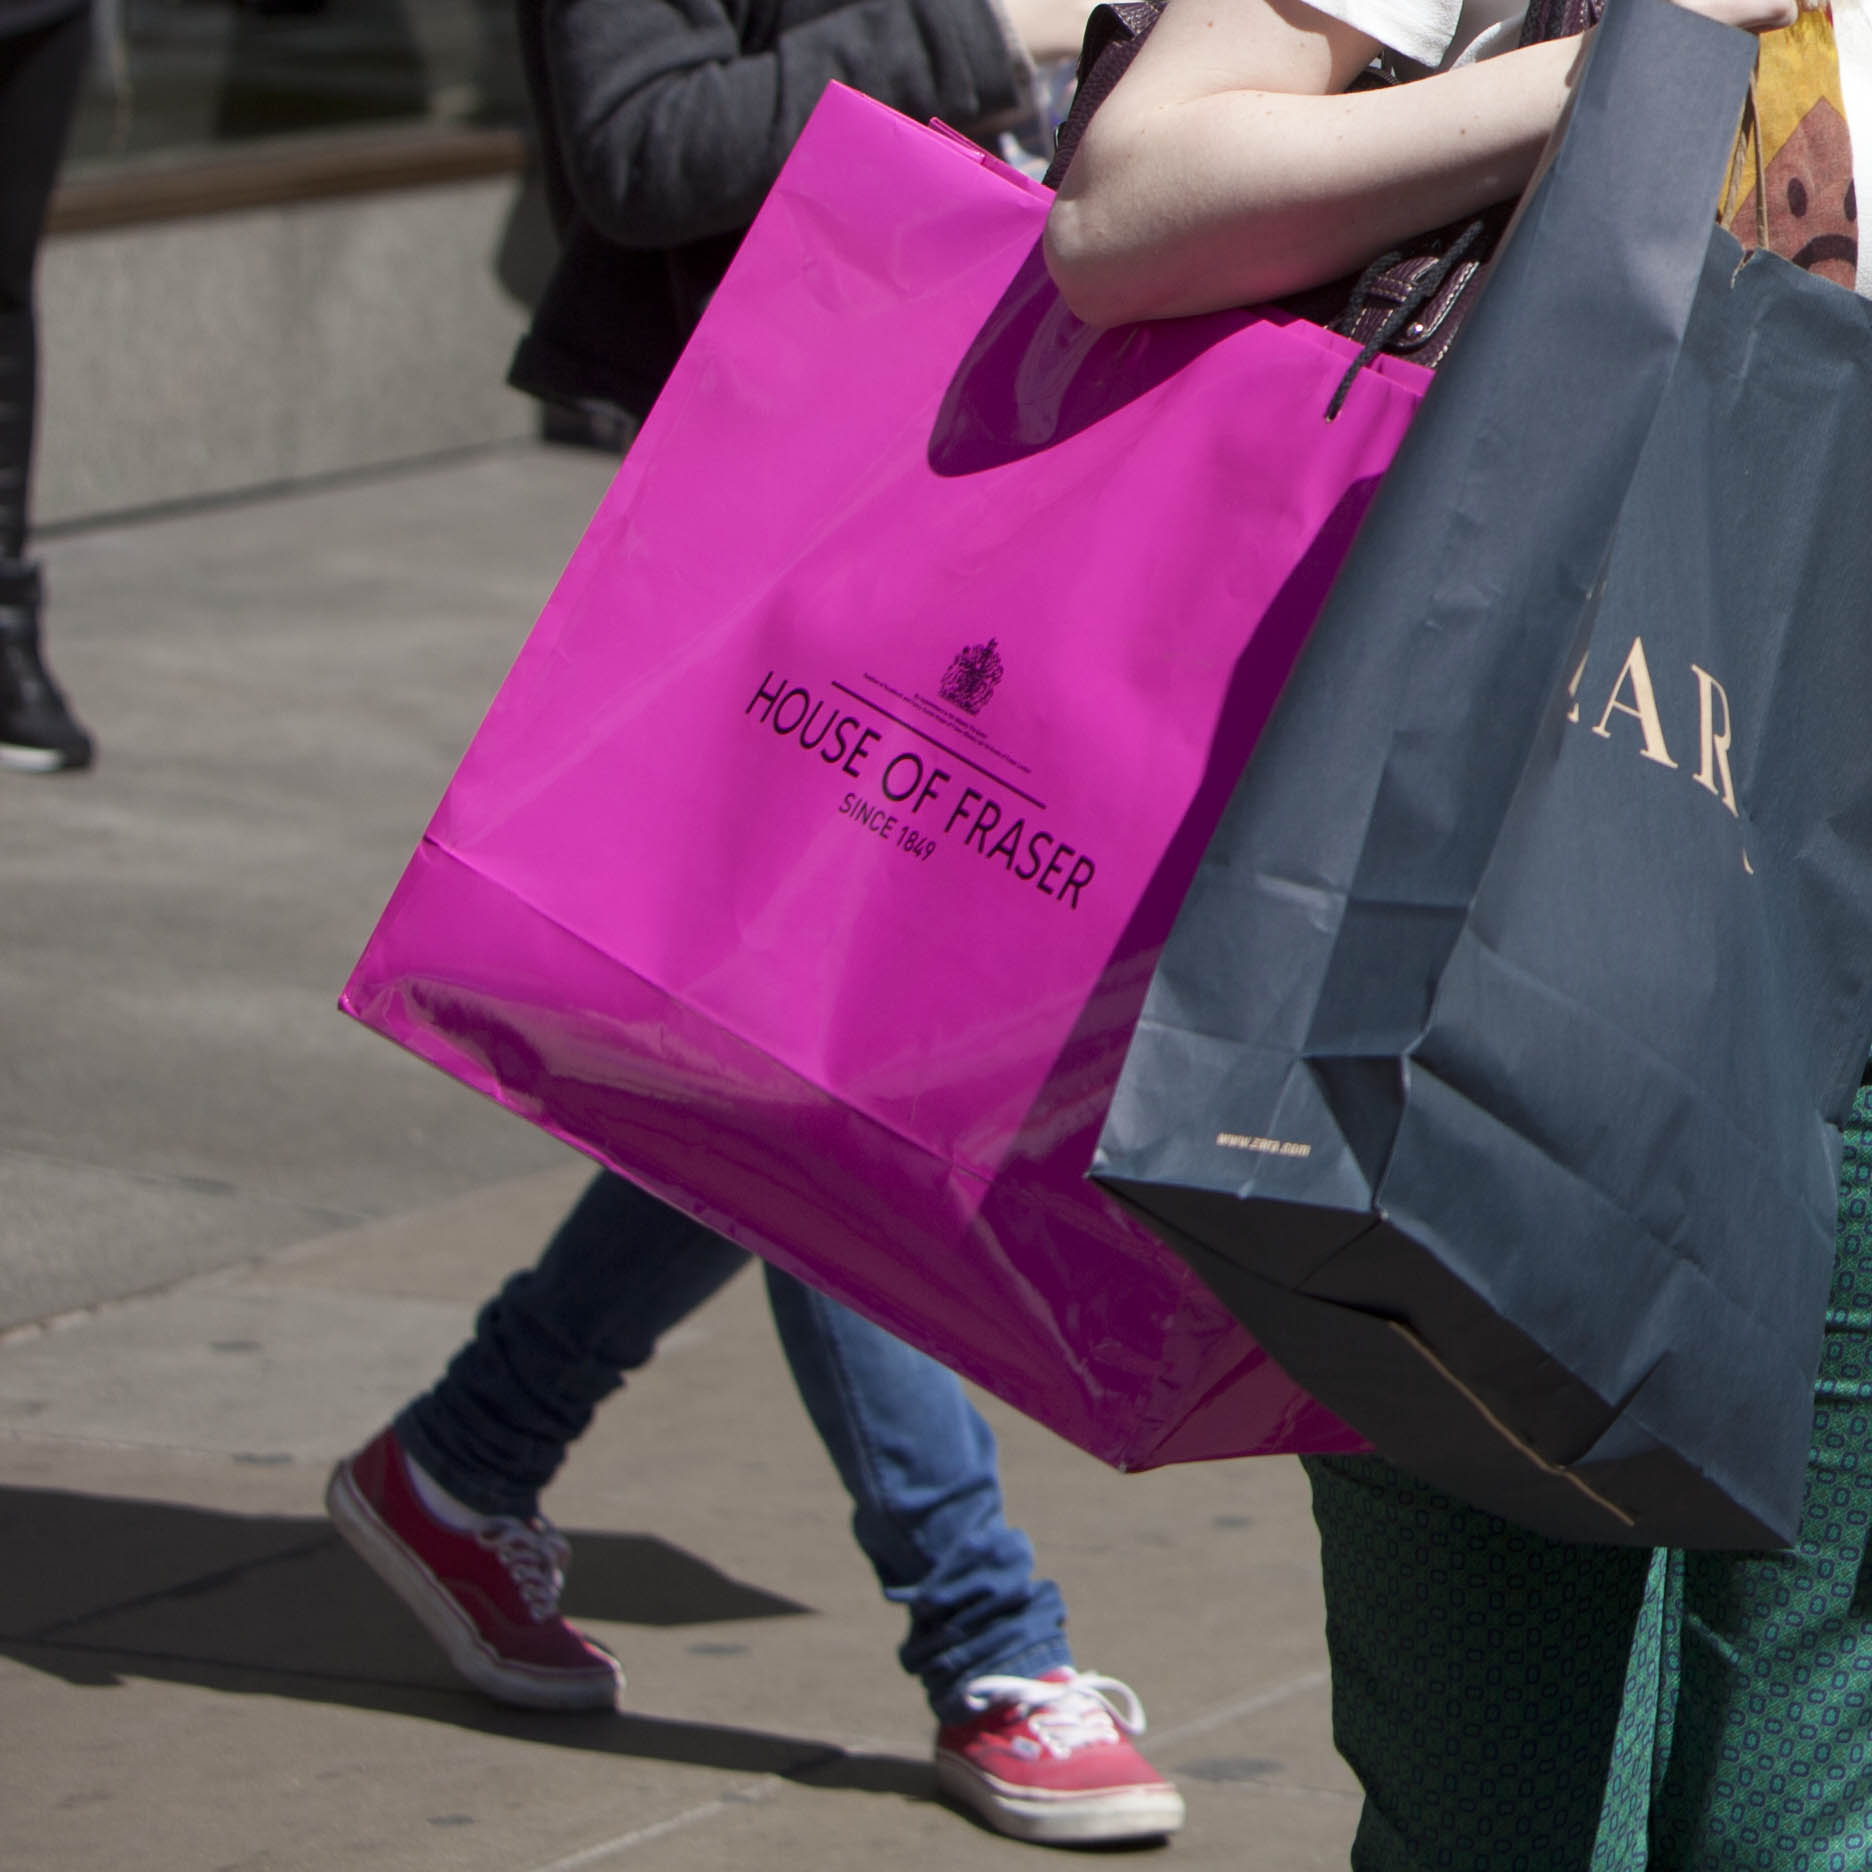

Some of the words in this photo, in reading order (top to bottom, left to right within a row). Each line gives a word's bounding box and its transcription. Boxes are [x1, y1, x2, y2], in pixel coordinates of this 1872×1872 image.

[745, 670, 882, 779] HOUSE
[881, 752, 951, 814] OF
[943, 787, 1097, 911] FRASER
[839, 792, 899, 840] SINCE
[896, 825, 937, 862] 1849
